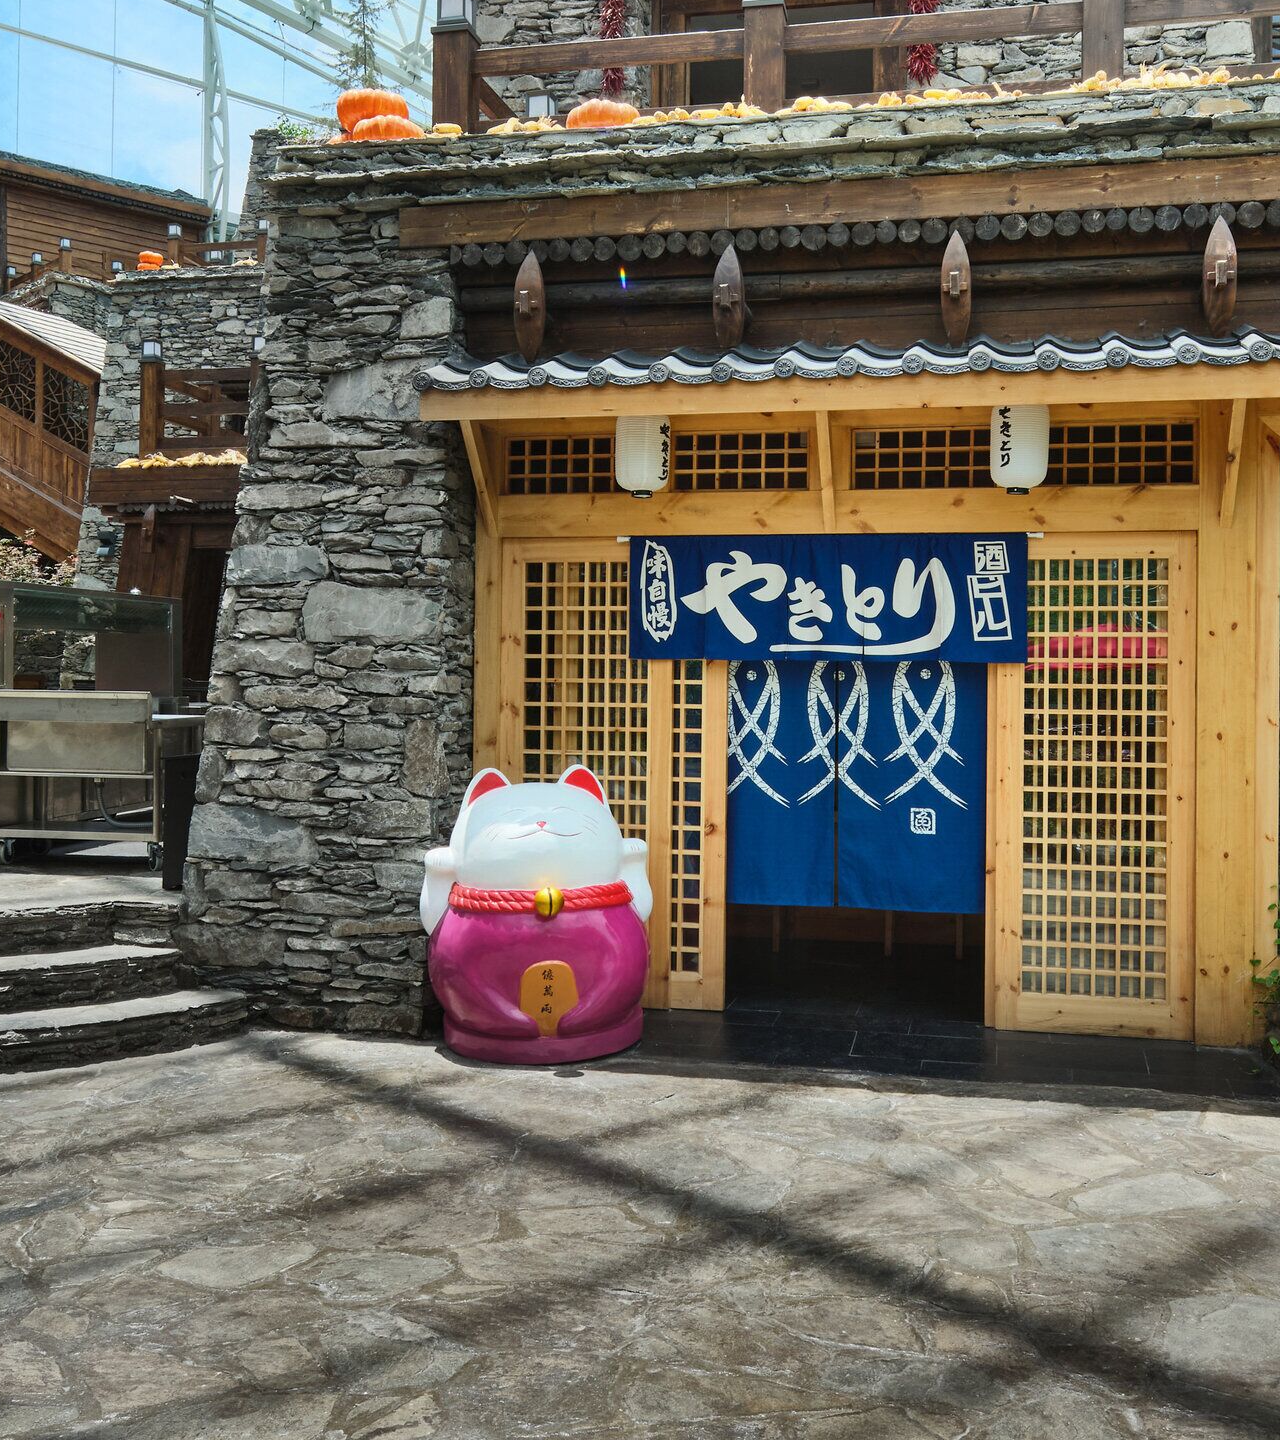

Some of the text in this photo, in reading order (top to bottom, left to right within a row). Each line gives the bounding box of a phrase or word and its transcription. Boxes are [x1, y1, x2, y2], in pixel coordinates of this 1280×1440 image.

[999, 406, 1012, 468] やきとり
[646, 549, 671, 630] 味自慢
[680, 550, 956, 656] やきとり
